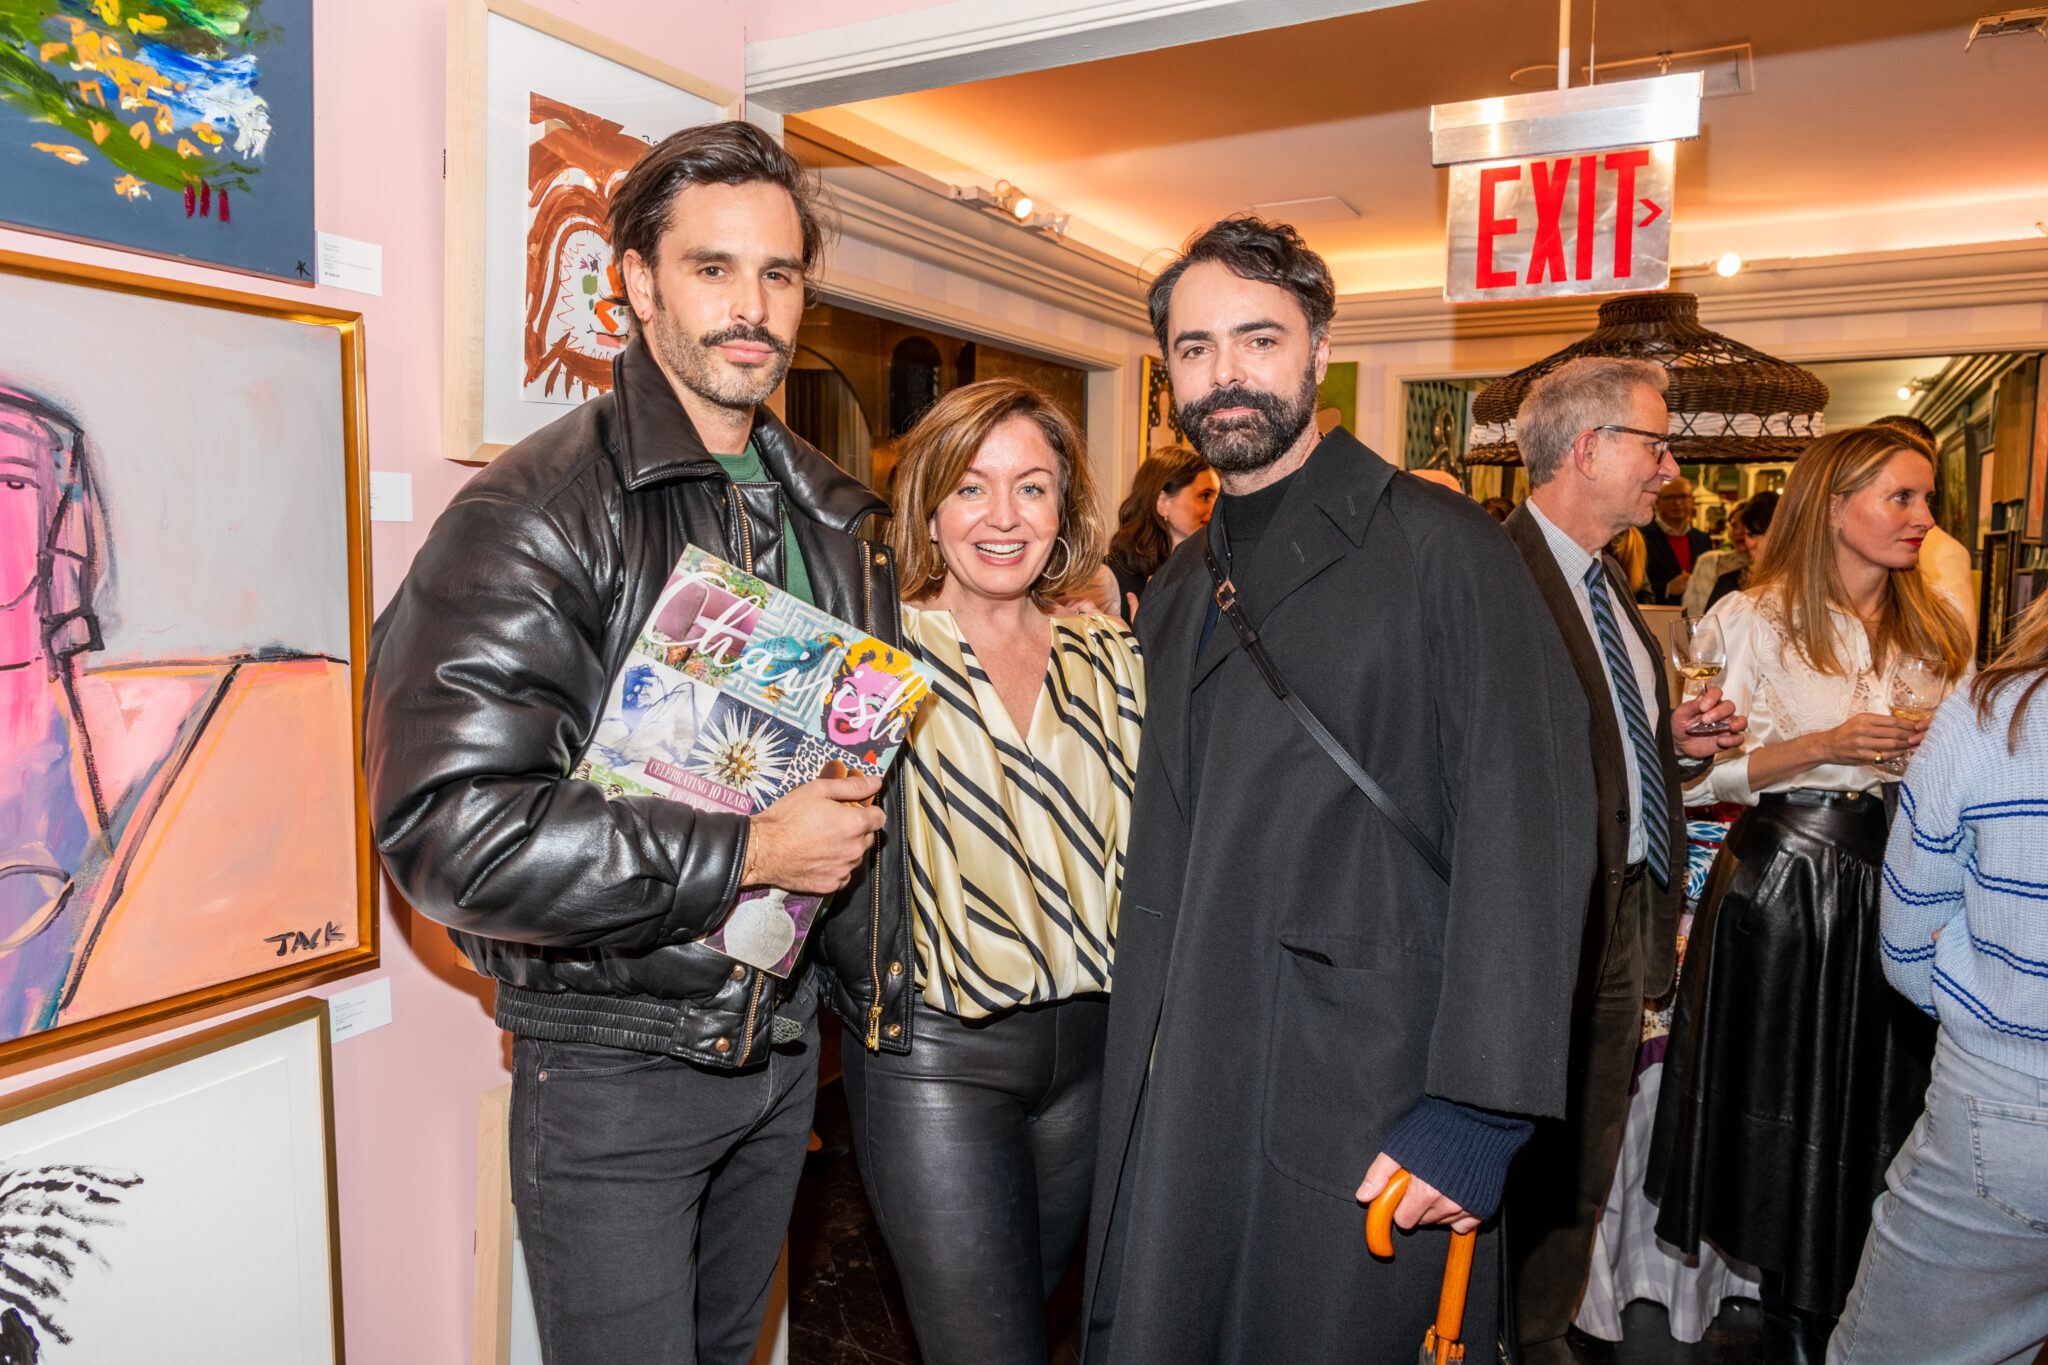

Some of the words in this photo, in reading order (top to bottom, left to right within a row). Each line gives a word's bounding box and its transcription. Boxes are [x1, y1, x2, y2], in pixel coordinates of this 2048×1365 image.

[1475, 149, 1650, 289] EXIT
[644, 571, 928, 744] Chairish
[648, 760, 709, 794] CELEBRATING
[707, 783, 722, 801] 10
[720, 789, 752, 811] YEARS
